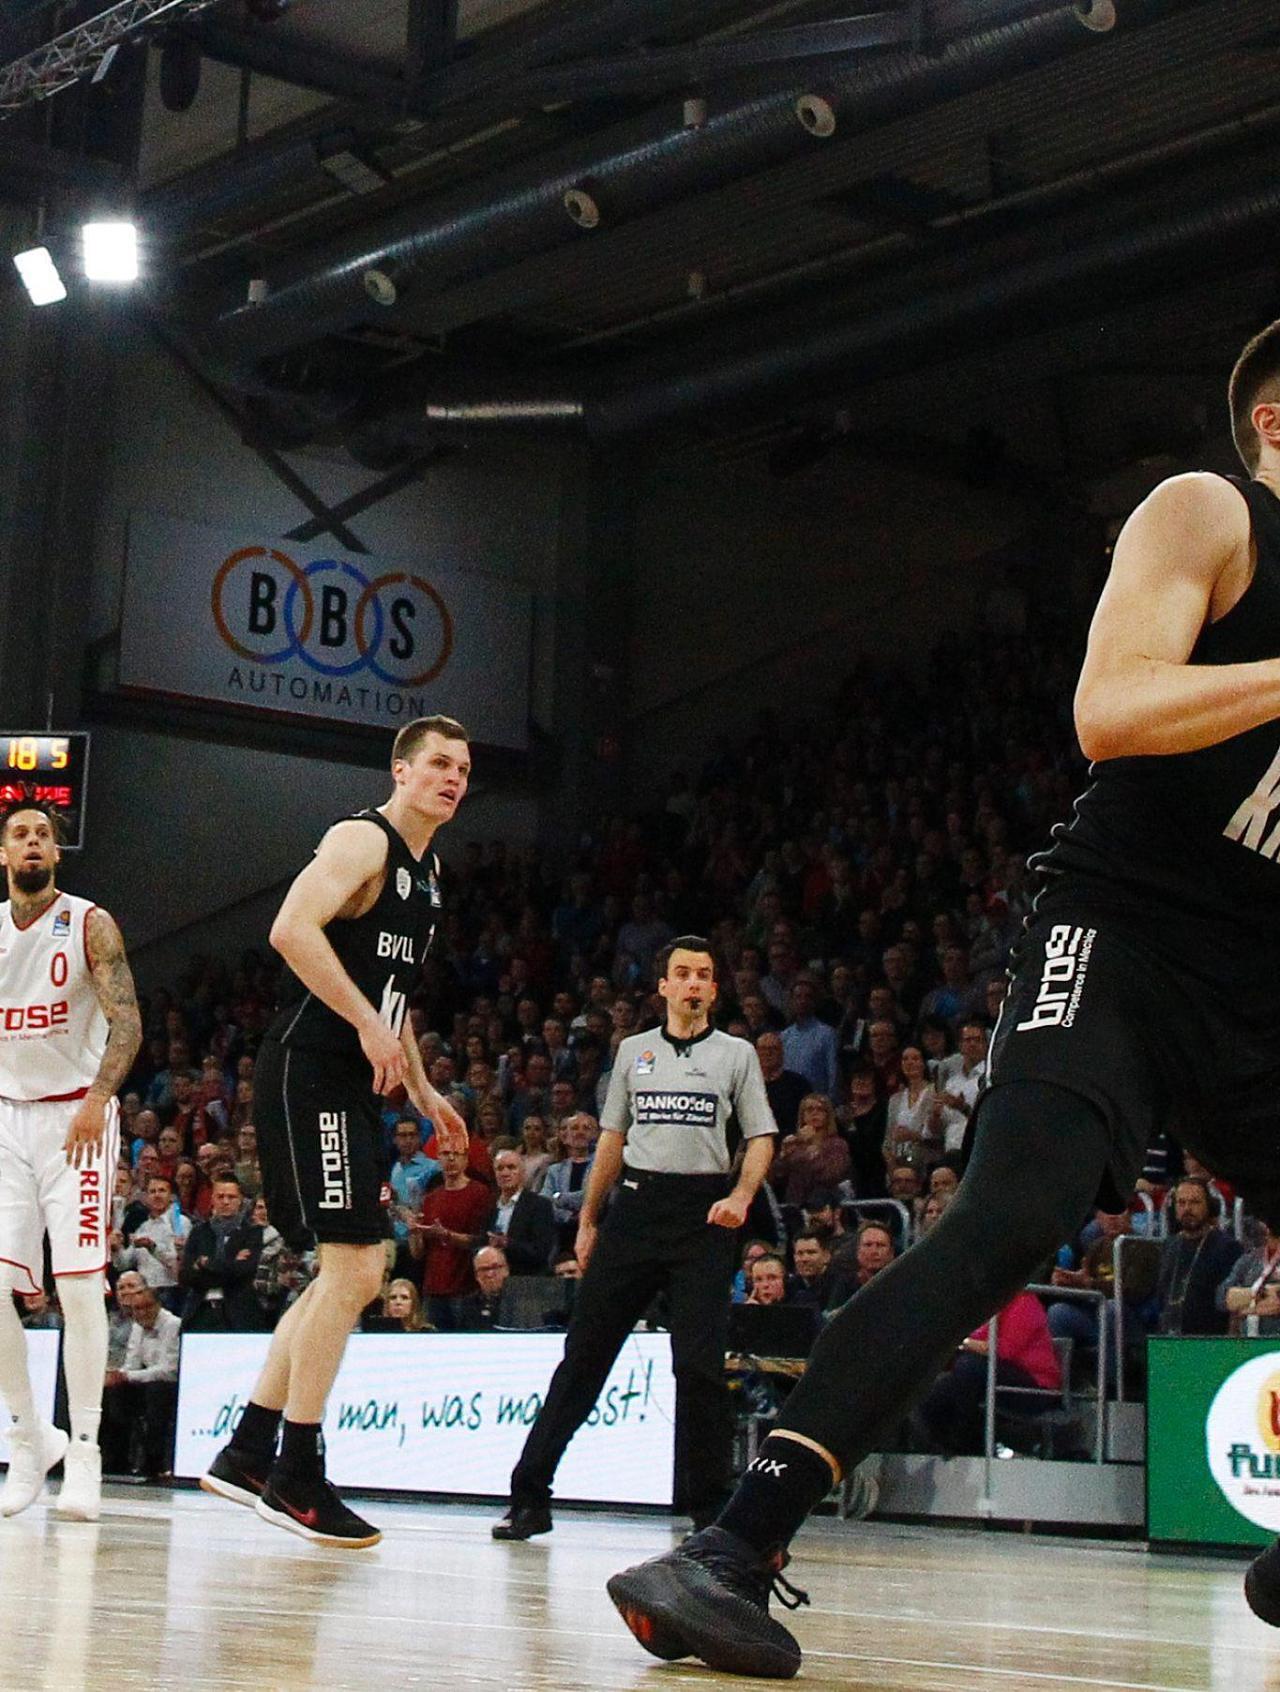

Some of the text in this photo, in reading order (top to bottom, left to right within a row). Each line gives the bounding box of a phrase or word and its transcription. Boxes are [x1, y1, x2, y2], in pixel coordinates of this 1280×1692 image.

[249, 571, 416, 660] BBS
[228, 667, 425, 717] AUTOMATION
[51, 951, 68, 987] 0
[318, 1111, 345, 1209] brose
[79, 1169, 100, 1248] REWE
[338, 1399, 406, 1447] man,
[422, 1391, 481, 1430] was
